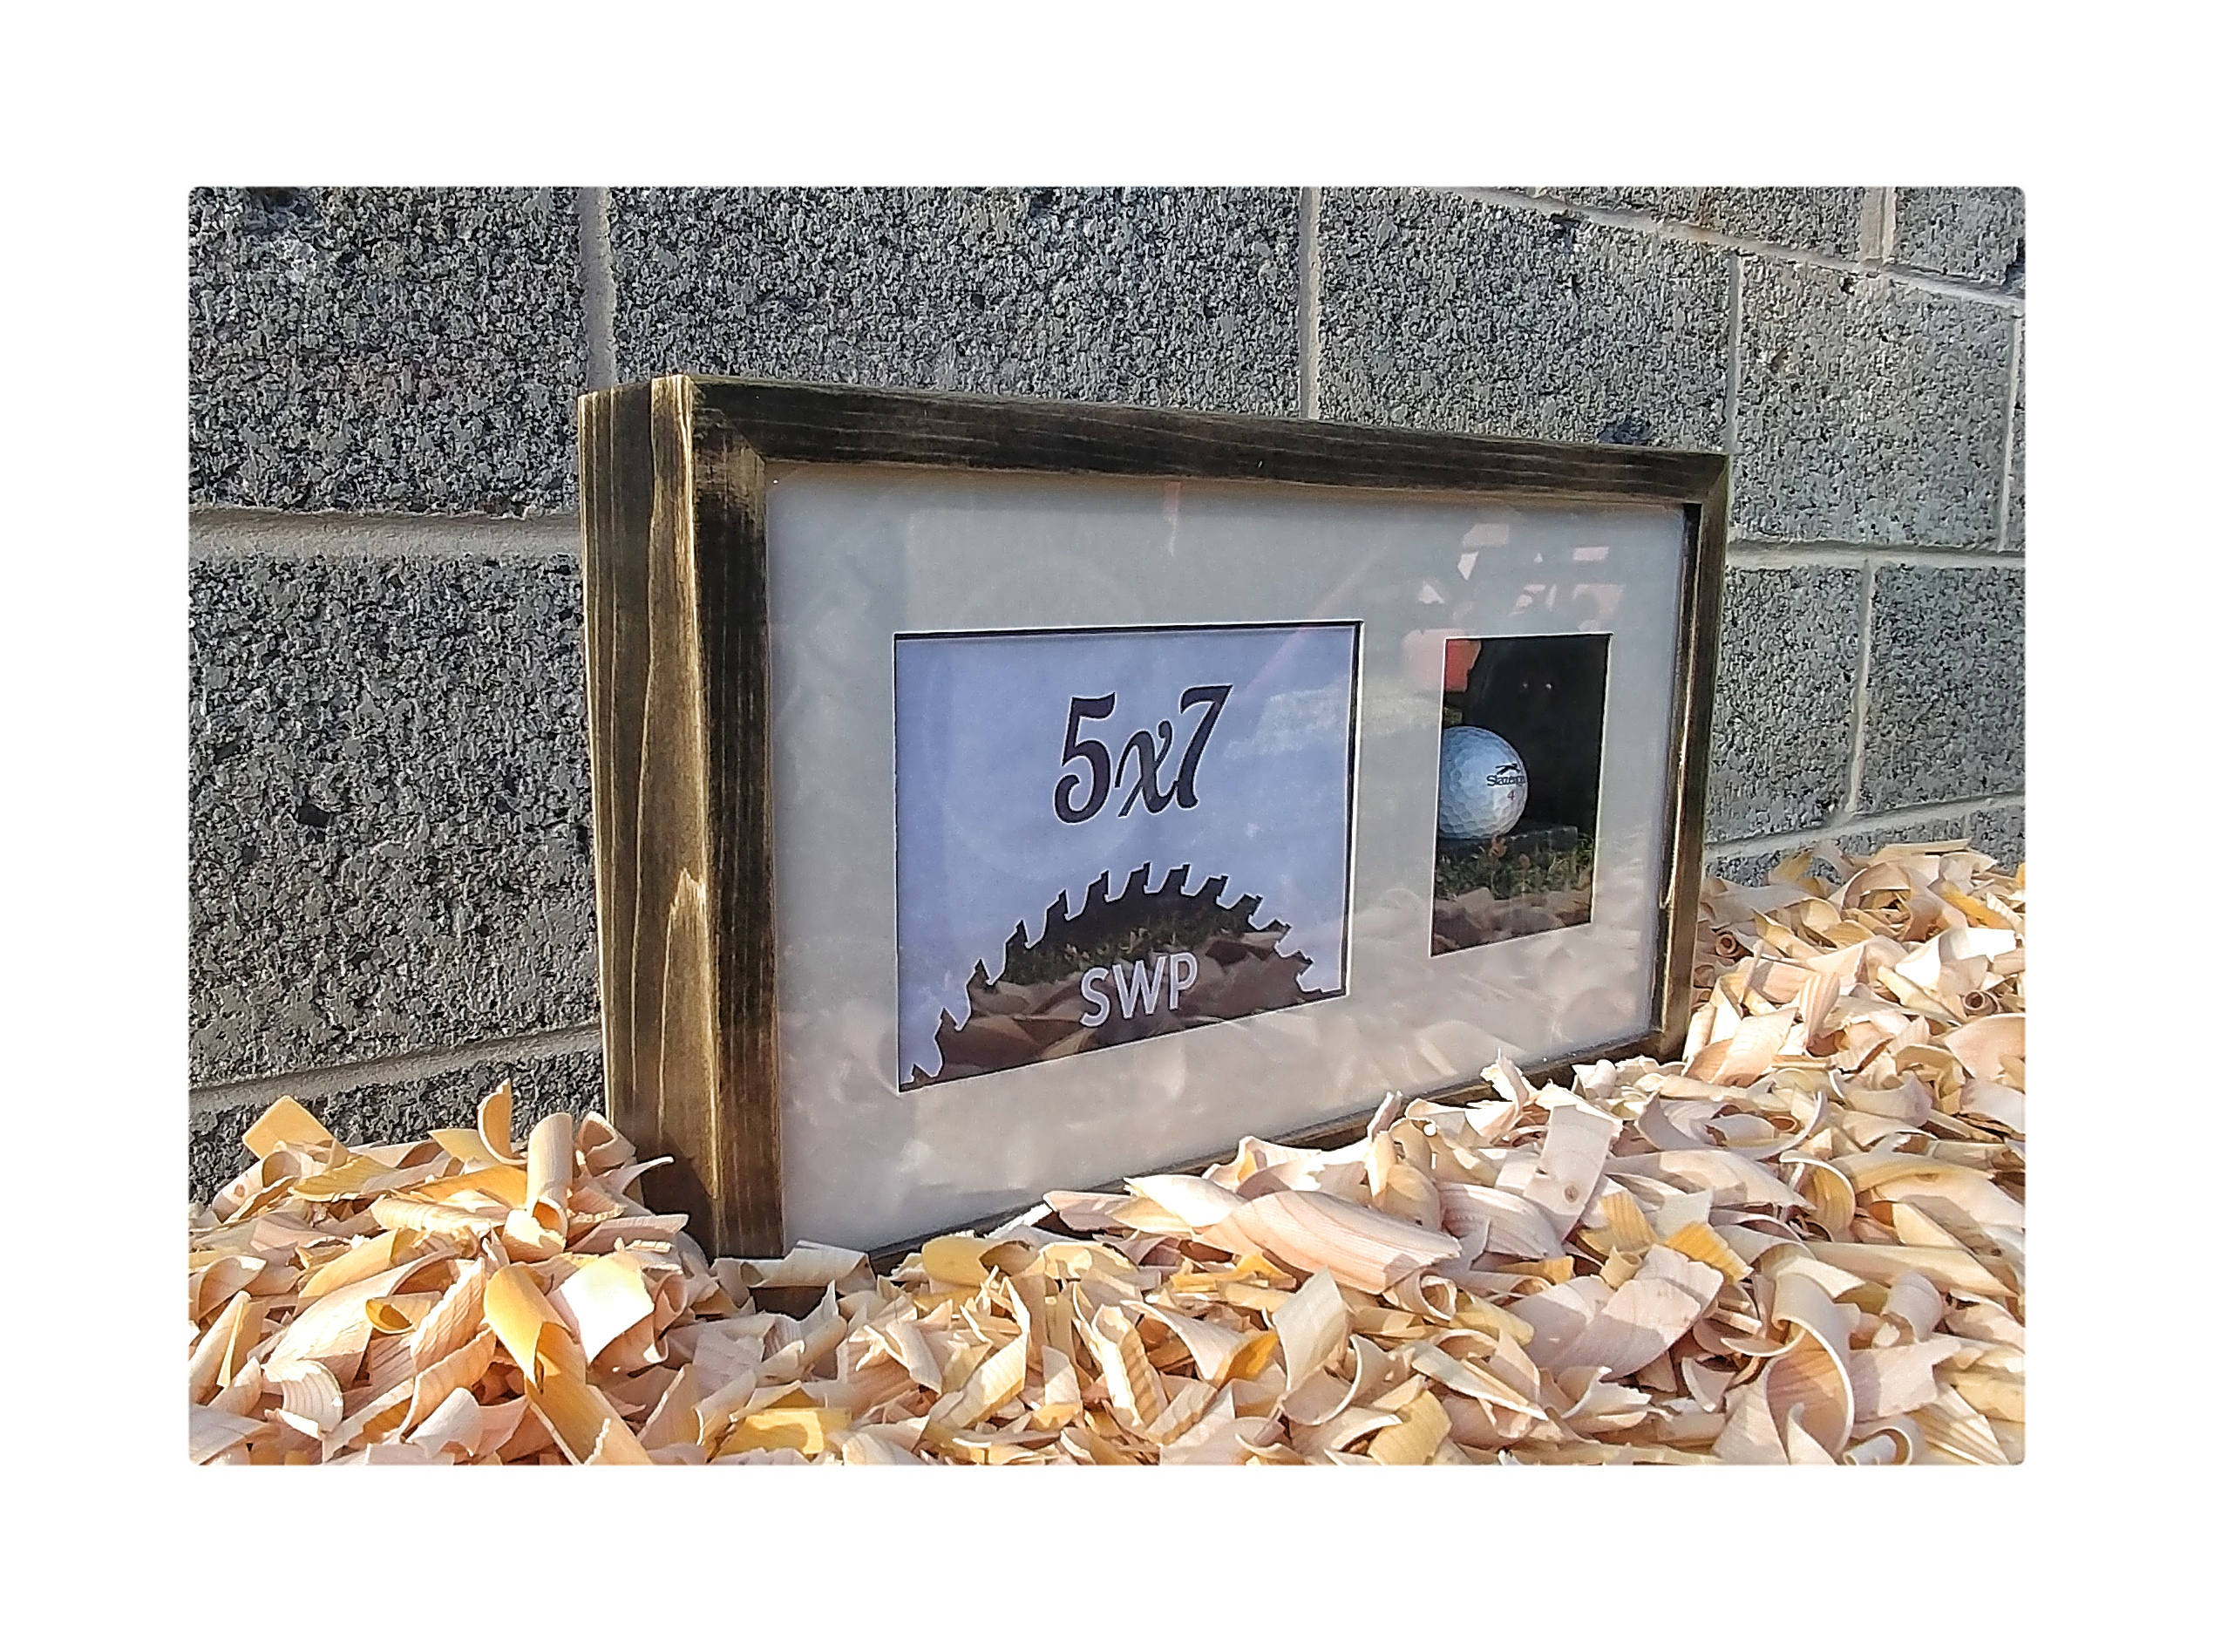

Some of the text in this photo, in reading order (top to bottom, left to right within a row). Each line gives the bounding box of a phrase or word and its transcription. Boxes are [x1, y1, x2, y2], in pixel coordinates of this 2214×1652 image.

[1054, 684, 1233, 824] 5x7
[1486, 774, 1526, 786] Slazeng
[1507, 789, 1515, 800] 4
[1080, 952, 1198, 1028] SWP
